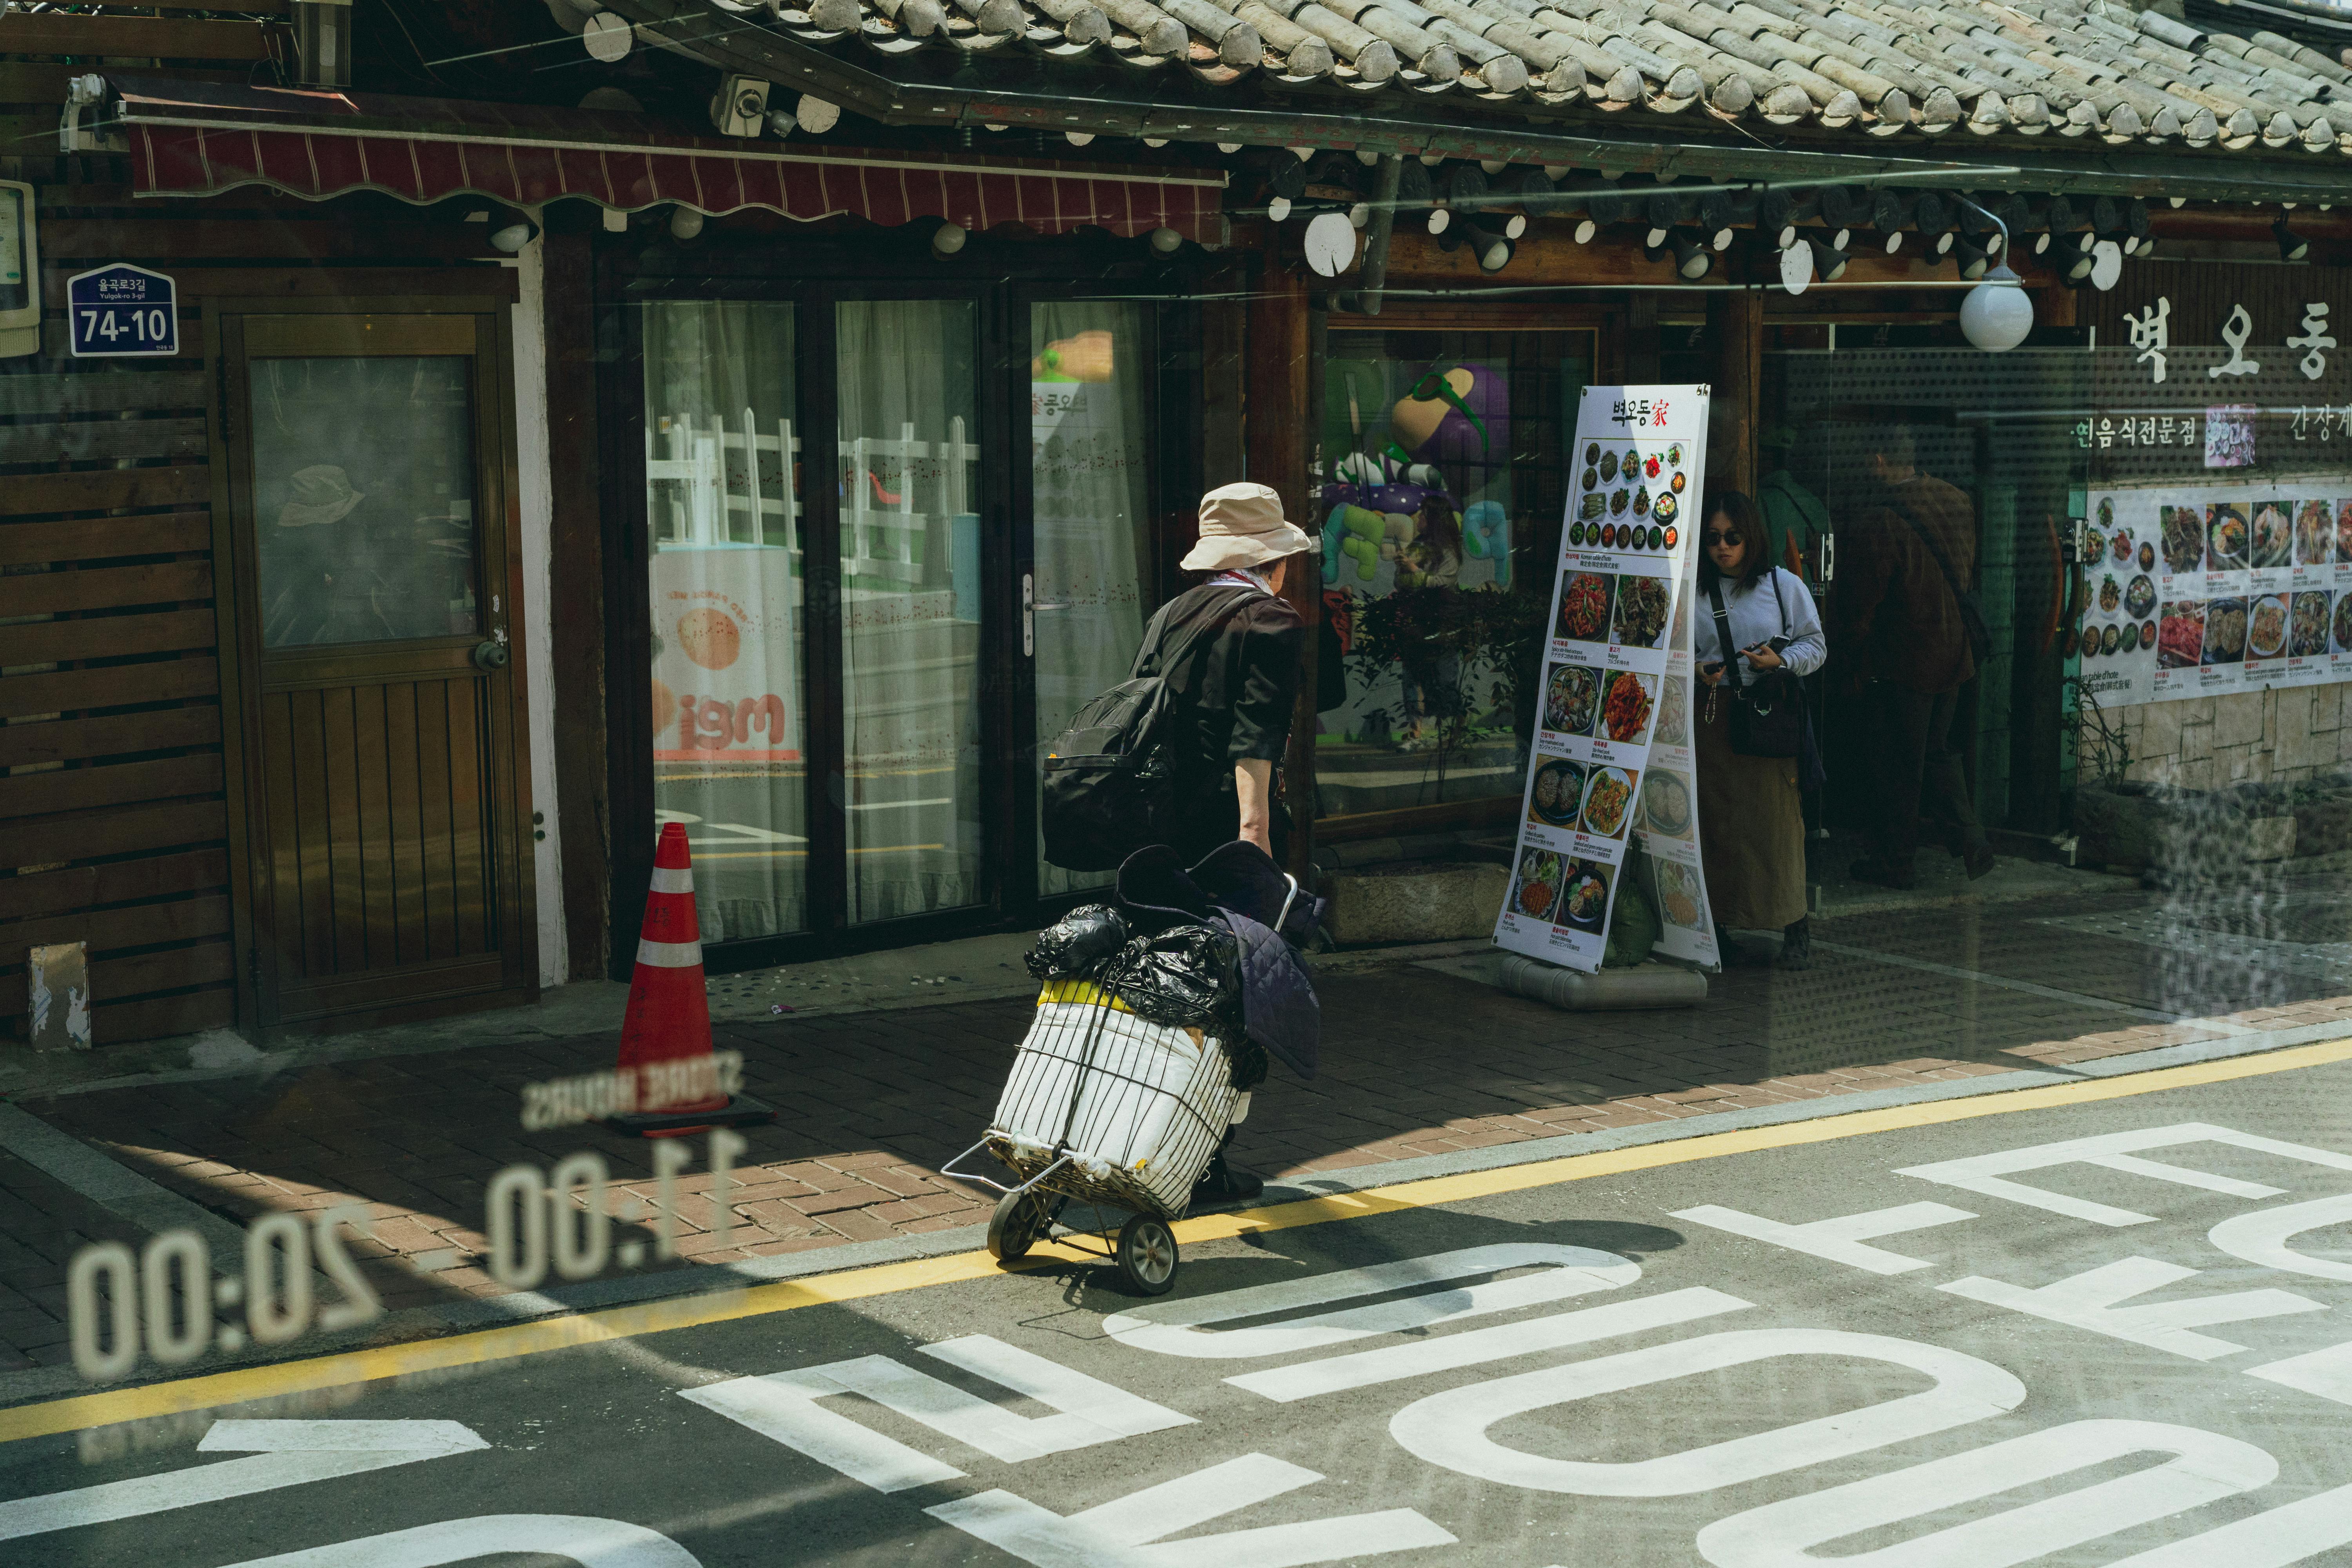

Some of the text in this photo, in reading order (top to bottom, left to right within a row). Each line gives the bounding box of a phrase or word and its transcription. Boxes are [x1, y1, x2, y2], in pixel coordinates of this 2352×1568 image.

[98, 279, 145, 292] 율곡로3길
[80, 309, 166, 342] 74-10
[2071, 417, 2195, 448] 연음식전문점
[2089, 671, 2102, 681] table
[2102, 670, 2119, 679] d'hote
